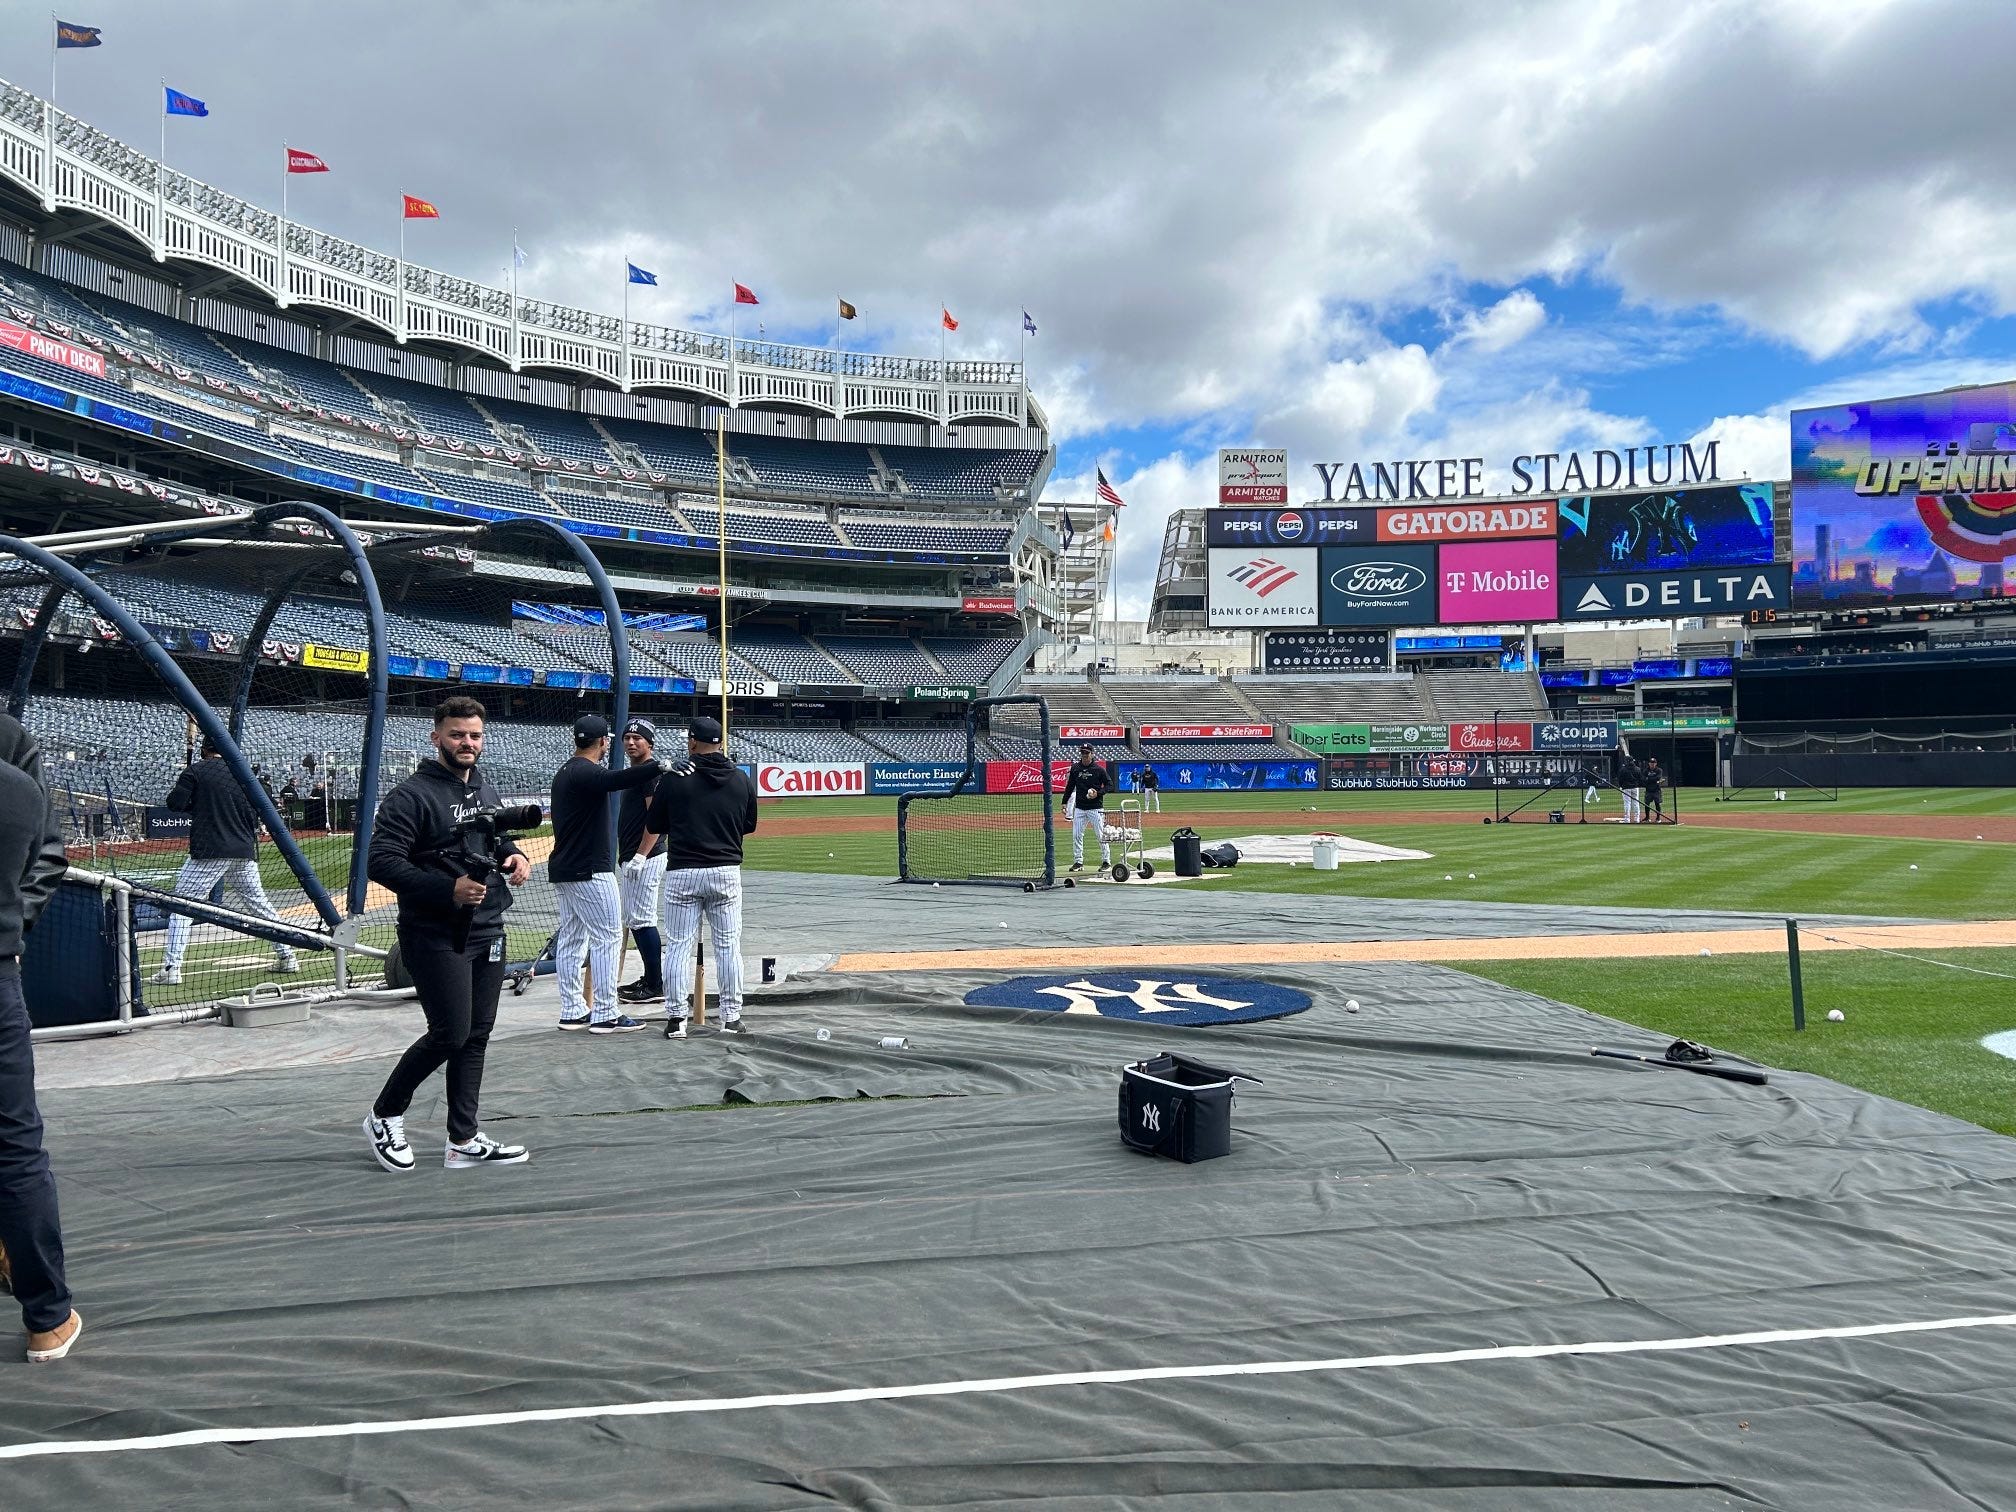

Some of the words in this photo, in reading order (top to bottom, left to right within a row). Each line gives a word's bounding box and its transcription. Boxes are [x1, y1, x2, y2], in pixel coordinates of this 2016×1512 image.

[30, 335, 68, 363] PARTY
[70, 350, 101, 374] DECK
[1224, 454, 1284, 464] ARMITRON
[1312, 458, 1484, 501] YANKEE
[1511, 440, 1720, 495] STADIUM
[1227, 487, 1281, 496] ARMITRON
[1224, 521, 1262, 532] PEPSI
[1278, 522, 1302, 530] PEPSI
[1319, 520, 1358, 531] PEPSI
[1387, 506, 1548, 535] GATORADE
[1347, 567, 1409, 592] Ford
[1446, 572, 1466, 593] T
[1472, 569, 1550, 592] Mobile
[725, 587, 751, 598] ANKEES
[752, 589, 768, 598] CLUB
[1626, 575, 1775, 607] DELTA
[1347, 599, 1410, 608] BuyFordNow.com
[1211, 607, 1242, 616] BANK
[1245, 607, 1261, 616] OF
[1262, 606, 1315, 616] AMERICA
[914, 687, 941, 698] Poland
[942, 687, 969, 699] Spring
[1295, 733, 1327, 745] Uber
[1332, 732, 1366, 745] Eats
[1461, 725, 1523, 748] Chick-fil-A
[1562, 726, 1608, 742] coupa
[759, 766, 863, 793] Canon
[875, 768, 931, 780] Montefiore
[1331, 777, 1372, 788] StubHub
[1376, 777, 1418, 788] StubHub
[1422, 776, 1466, 788] StubHub
[1518, 778, 1541, 786] STARR
[1142, 1102, 1161, 1133] NY
